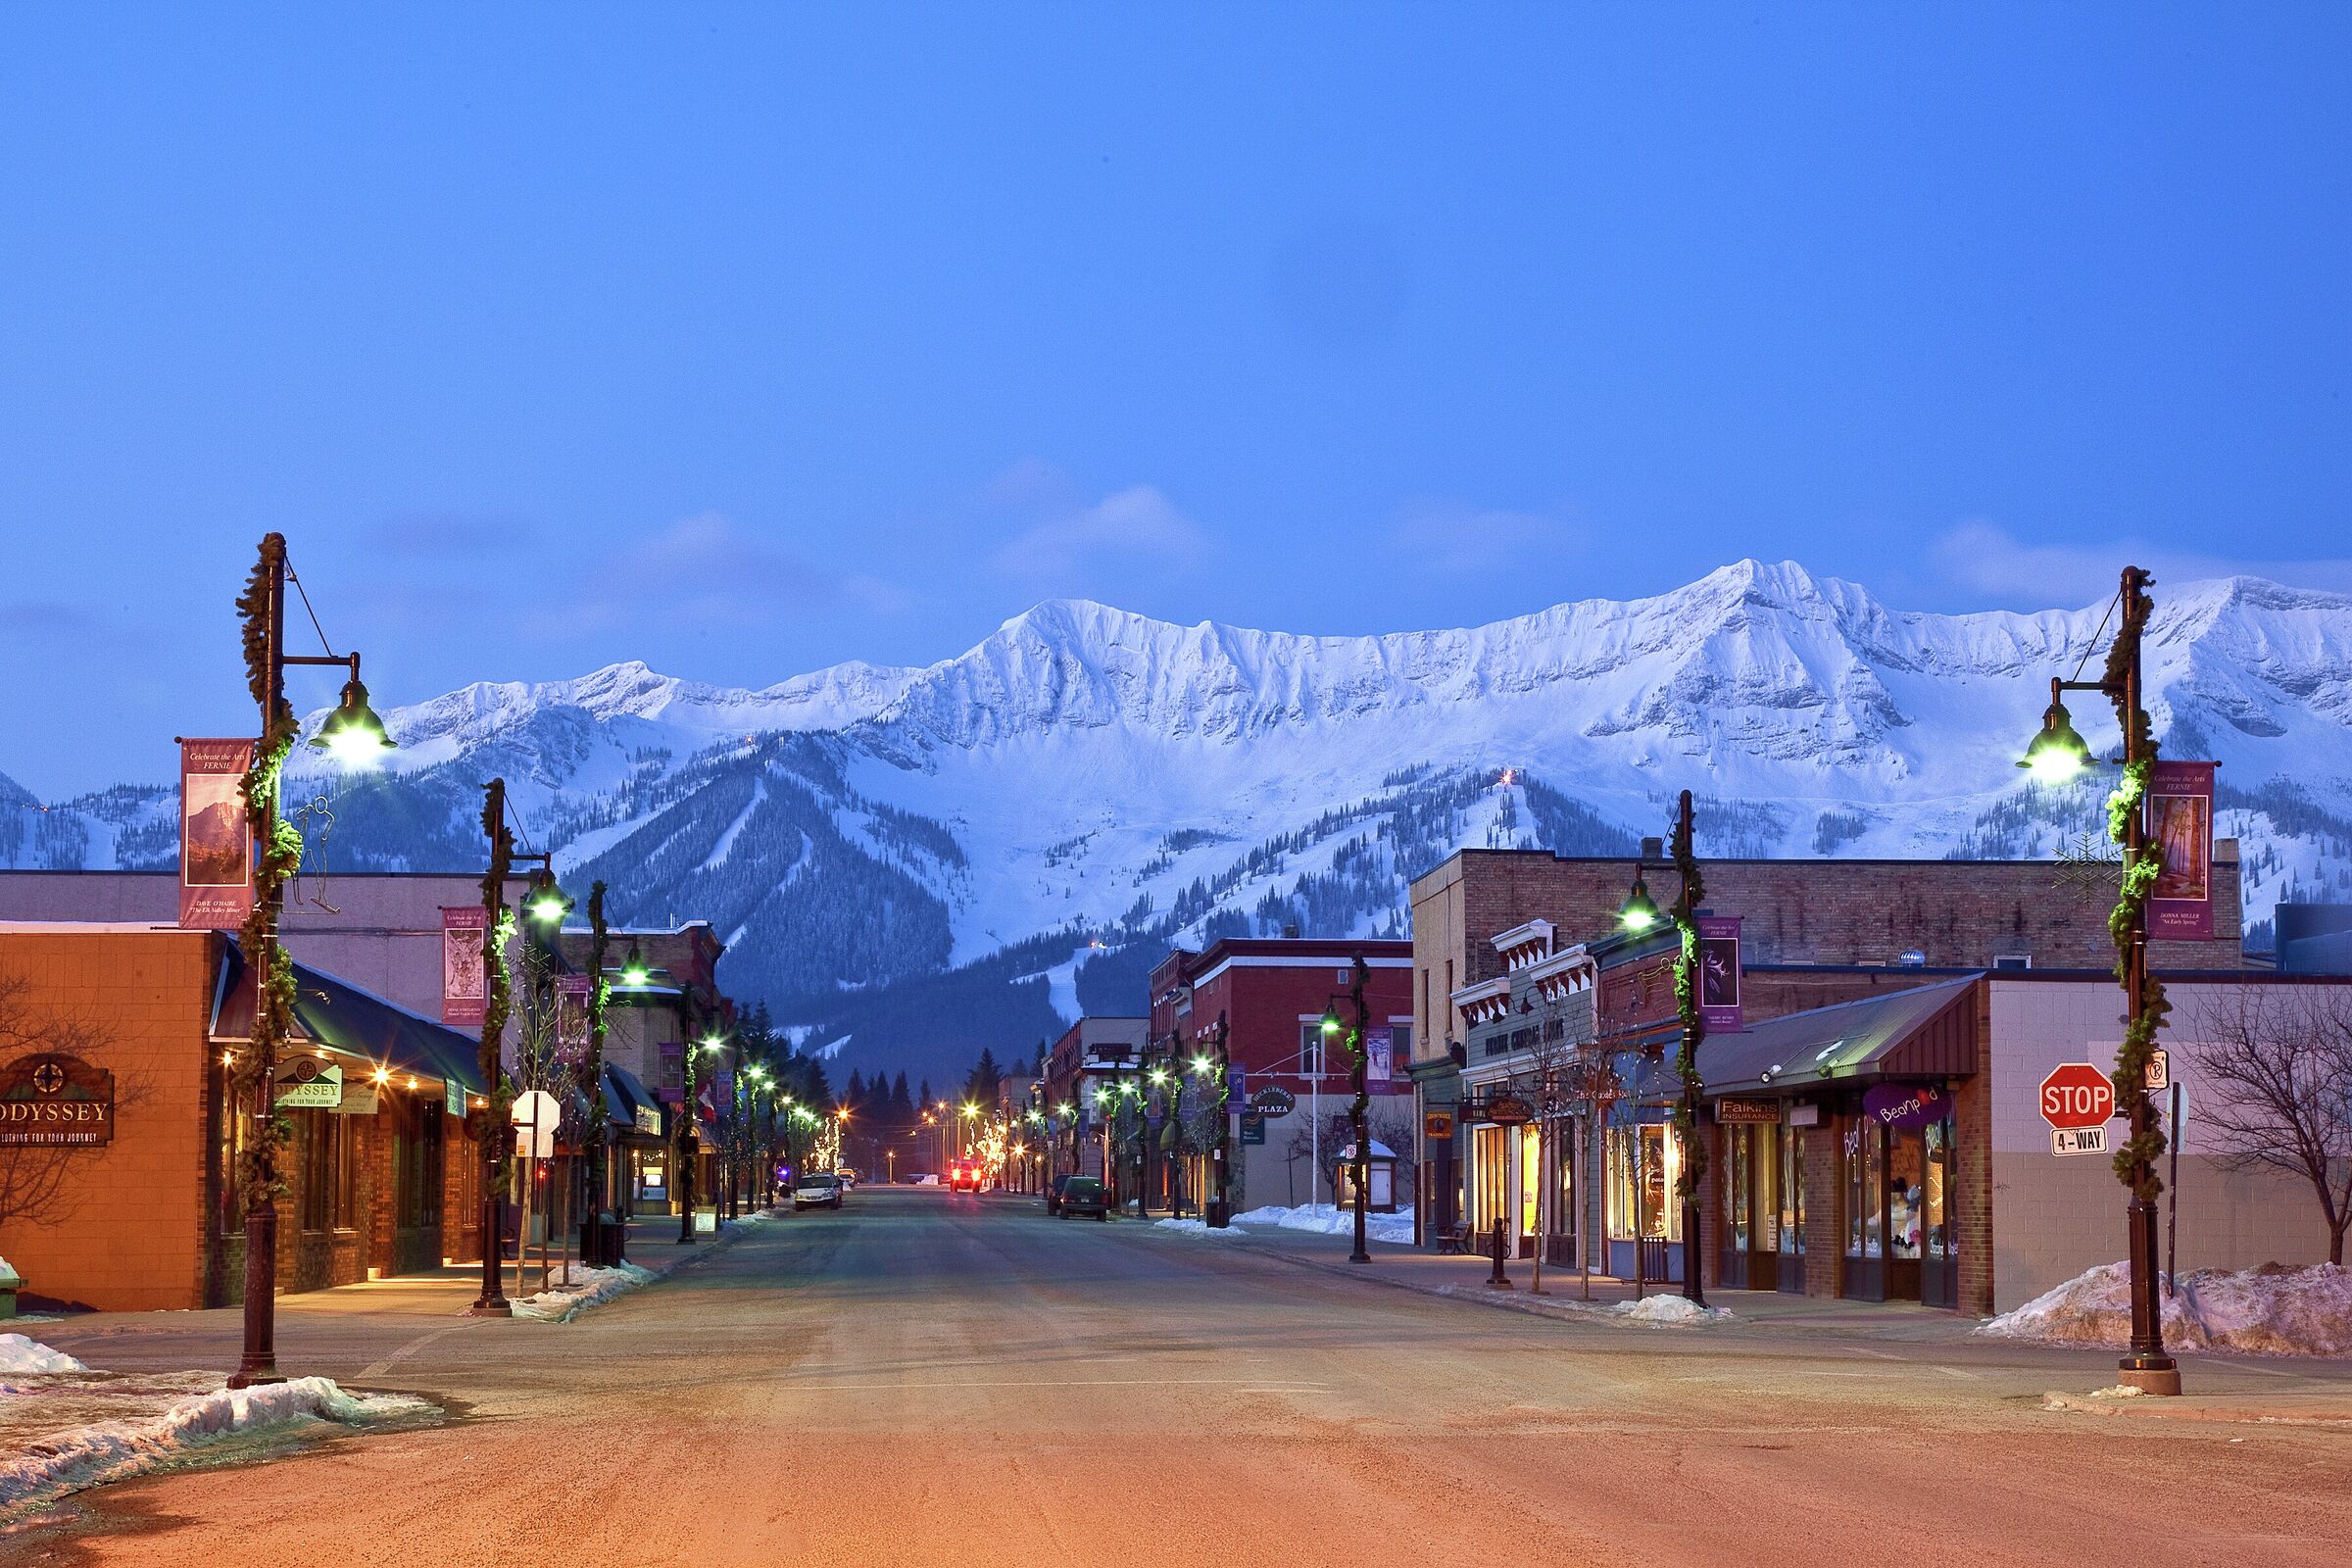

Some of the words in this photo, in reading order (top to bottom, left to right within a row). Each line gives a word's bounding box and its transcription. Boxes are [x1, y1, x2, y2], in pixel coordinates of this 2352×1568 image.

[1253, 1087, 1295, 1102] HUCKLEBERRY
[2044, 1085, 2110, 1114] STOP
[1722, 1102, 1778, 1113] Falkins
[1, 1133, 28, 1143] LOTHING
[32, 1133, 45, 1143] FOR
[48, 1133, 65, 1143] YOUR
[68, 1133, 97, 1143] JOURNEY
[2058, 1130, 2102, 1151] 4-WAY
